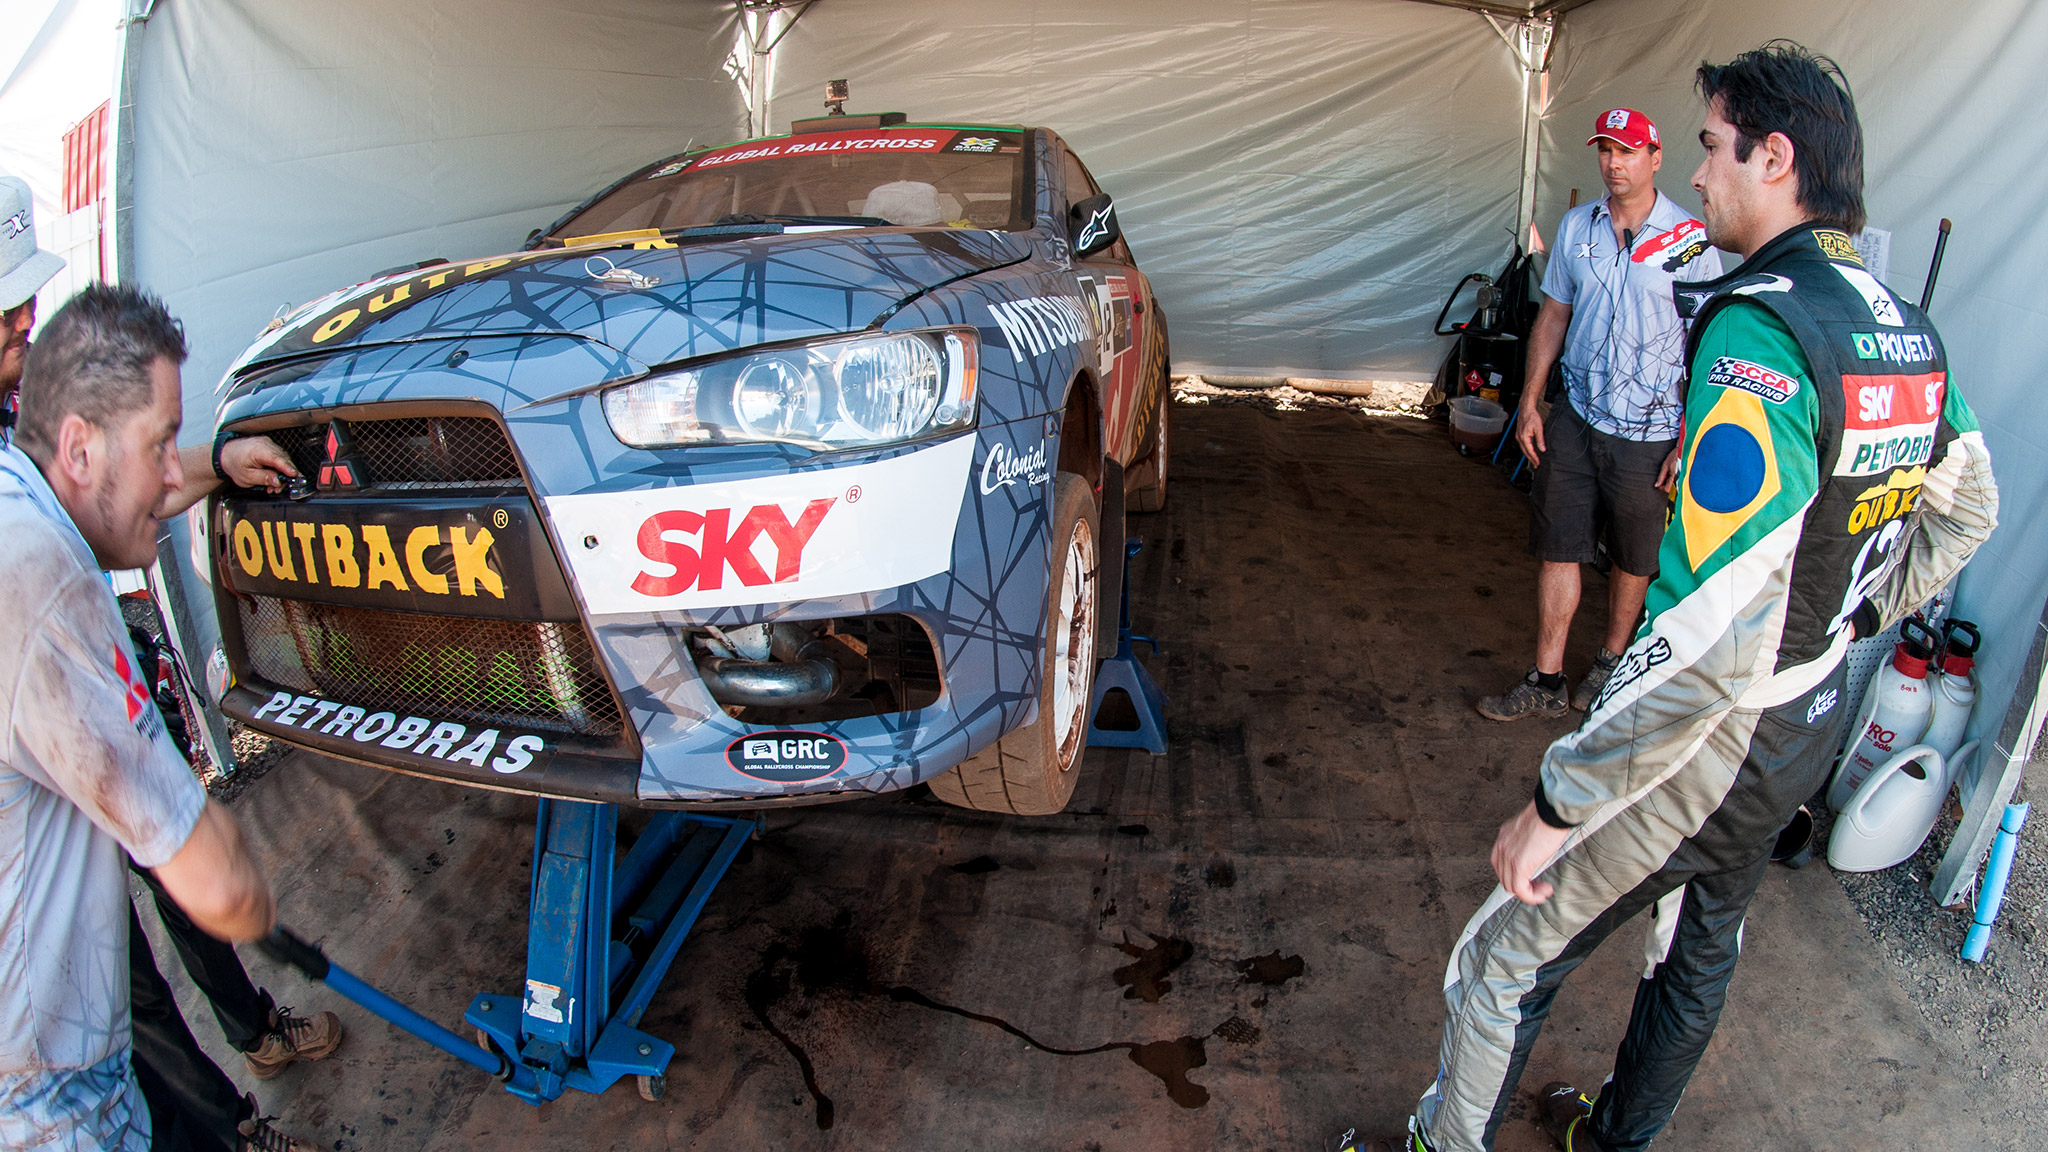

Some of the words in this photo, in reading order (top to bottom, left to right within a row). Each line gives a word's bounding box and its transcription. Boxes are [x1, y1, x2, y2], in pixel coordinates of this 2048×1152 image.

[698, 146, 780, 167] GLOBAL
[784, 138, 938, 154] RALLYCROSS
[1874, 332, 1922, 366] PIQUET
[1708, 374, 1730, 384] PRO
[1731, 377, 1785, 400] RACING
[1732, 363, 1788, 393] SCCA
[1859, 385, 1894, 421] SKY
[1925, 382, 1943, 415] SY
[981, 438, 1046, 496] Colonial
[1850, 435, 1932, 473] PETROBR
[1027, 472, 1050, 487] Racing
[233, 519, 505, 600] OUTBACK
[630, 497, 838, 597] SKY
[254, 692, 544, 774] PETROBRAS
[781, 739, 829, 760] GRC
[1873, 740, 1892, 752] solo
